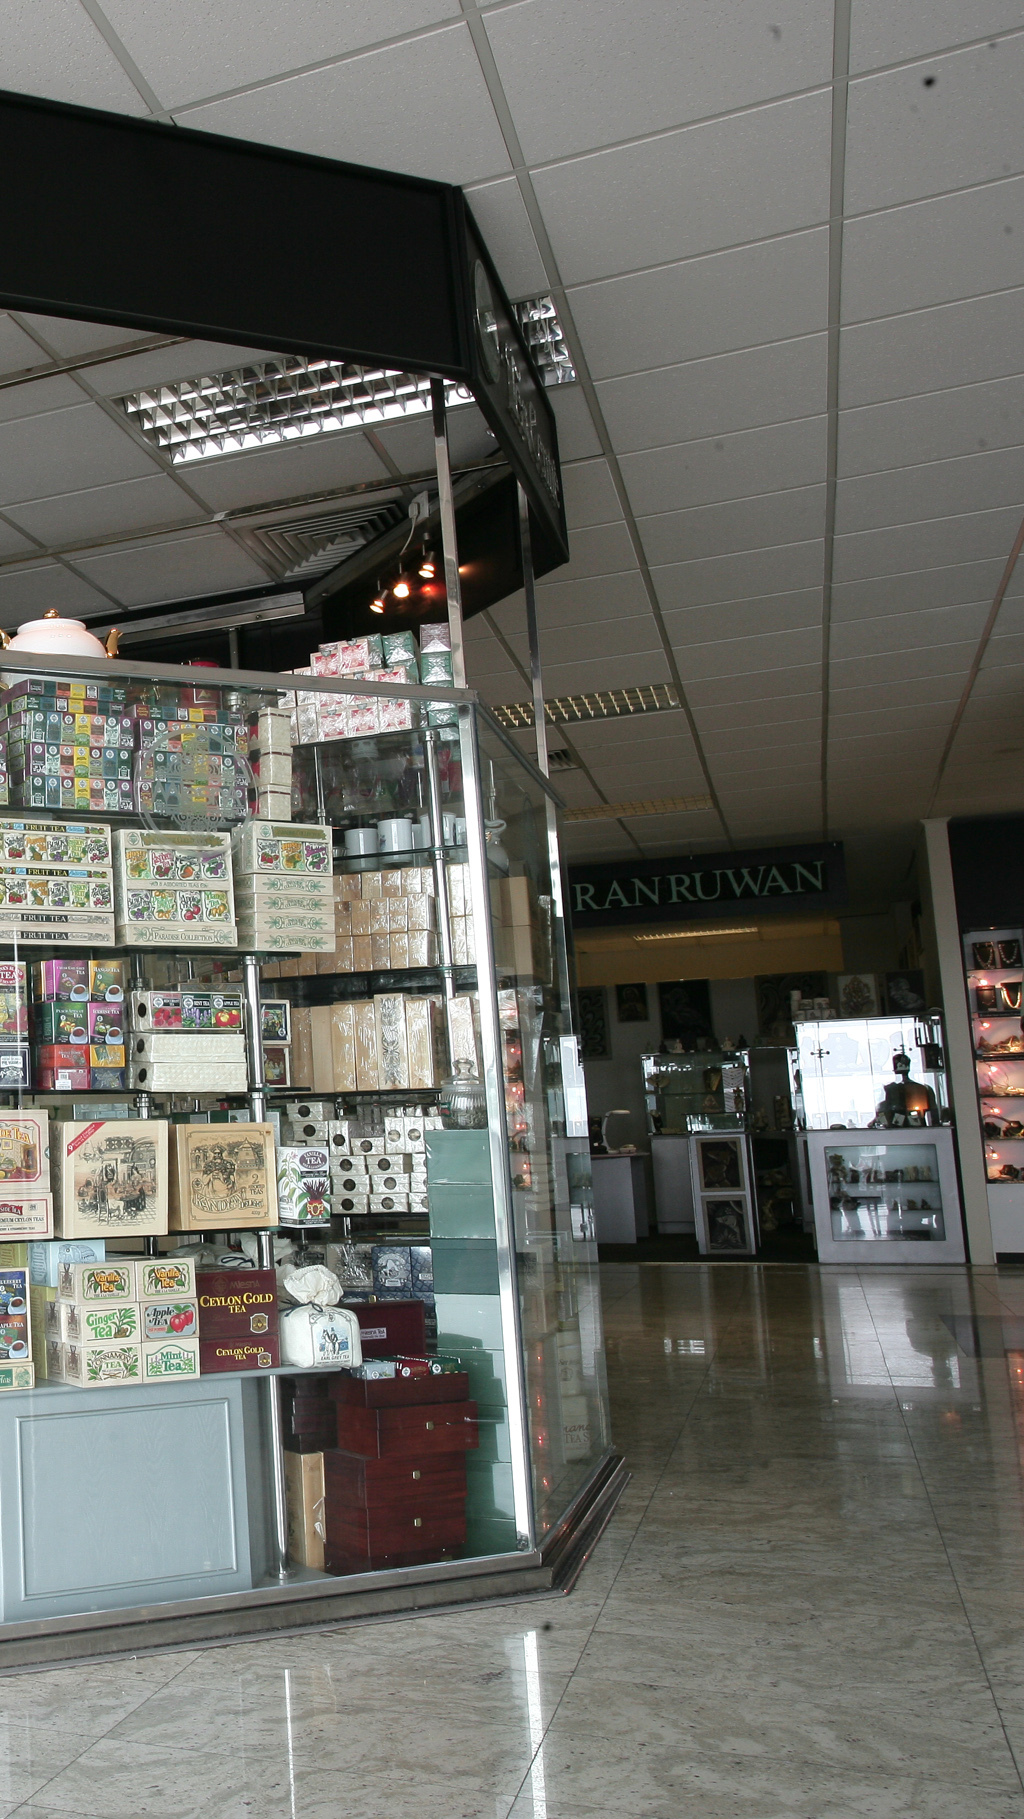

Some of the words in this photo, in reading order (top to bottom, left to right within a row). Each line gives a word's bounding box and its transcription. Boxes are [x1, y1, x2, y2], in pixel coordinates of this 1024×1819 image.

[50, 932, 67, 940] TEA
[154, 932, 180, 940] PARADISE
[180, 932, 212, 941] COLLECTION
[12, 1127, 31, 1144] TEA
[252, 1174, 260, 1184] 2
[94, 1272, 120, 1282] Vanilla
[155, 1268, 180, 1278] Vanilla
[99, 1282, 114, 1292] Tea
[160, 1277, 175, 1288] Tea
[200, 1296, 241, 1307] CEYLON
[243, 1292, 273, 1304] GOLD
[147, 1307, 175, 1319] Apple
[228, 1305, 246, 1313] TEA
[86, 1312, 117, 1327] Ginger
[149, 1316, 168, 1325] TEA
[91, 1326, 112, 1338] Tea
[160, 1352, 182, 1360] Mint
[216, 1348, 243, 1356] CEYLON
[244, 1346, 264, 1354] GOLD
[96, 1352, 132, 1365] CINNAMON
[162, 1361, 182, 1371] Tea
